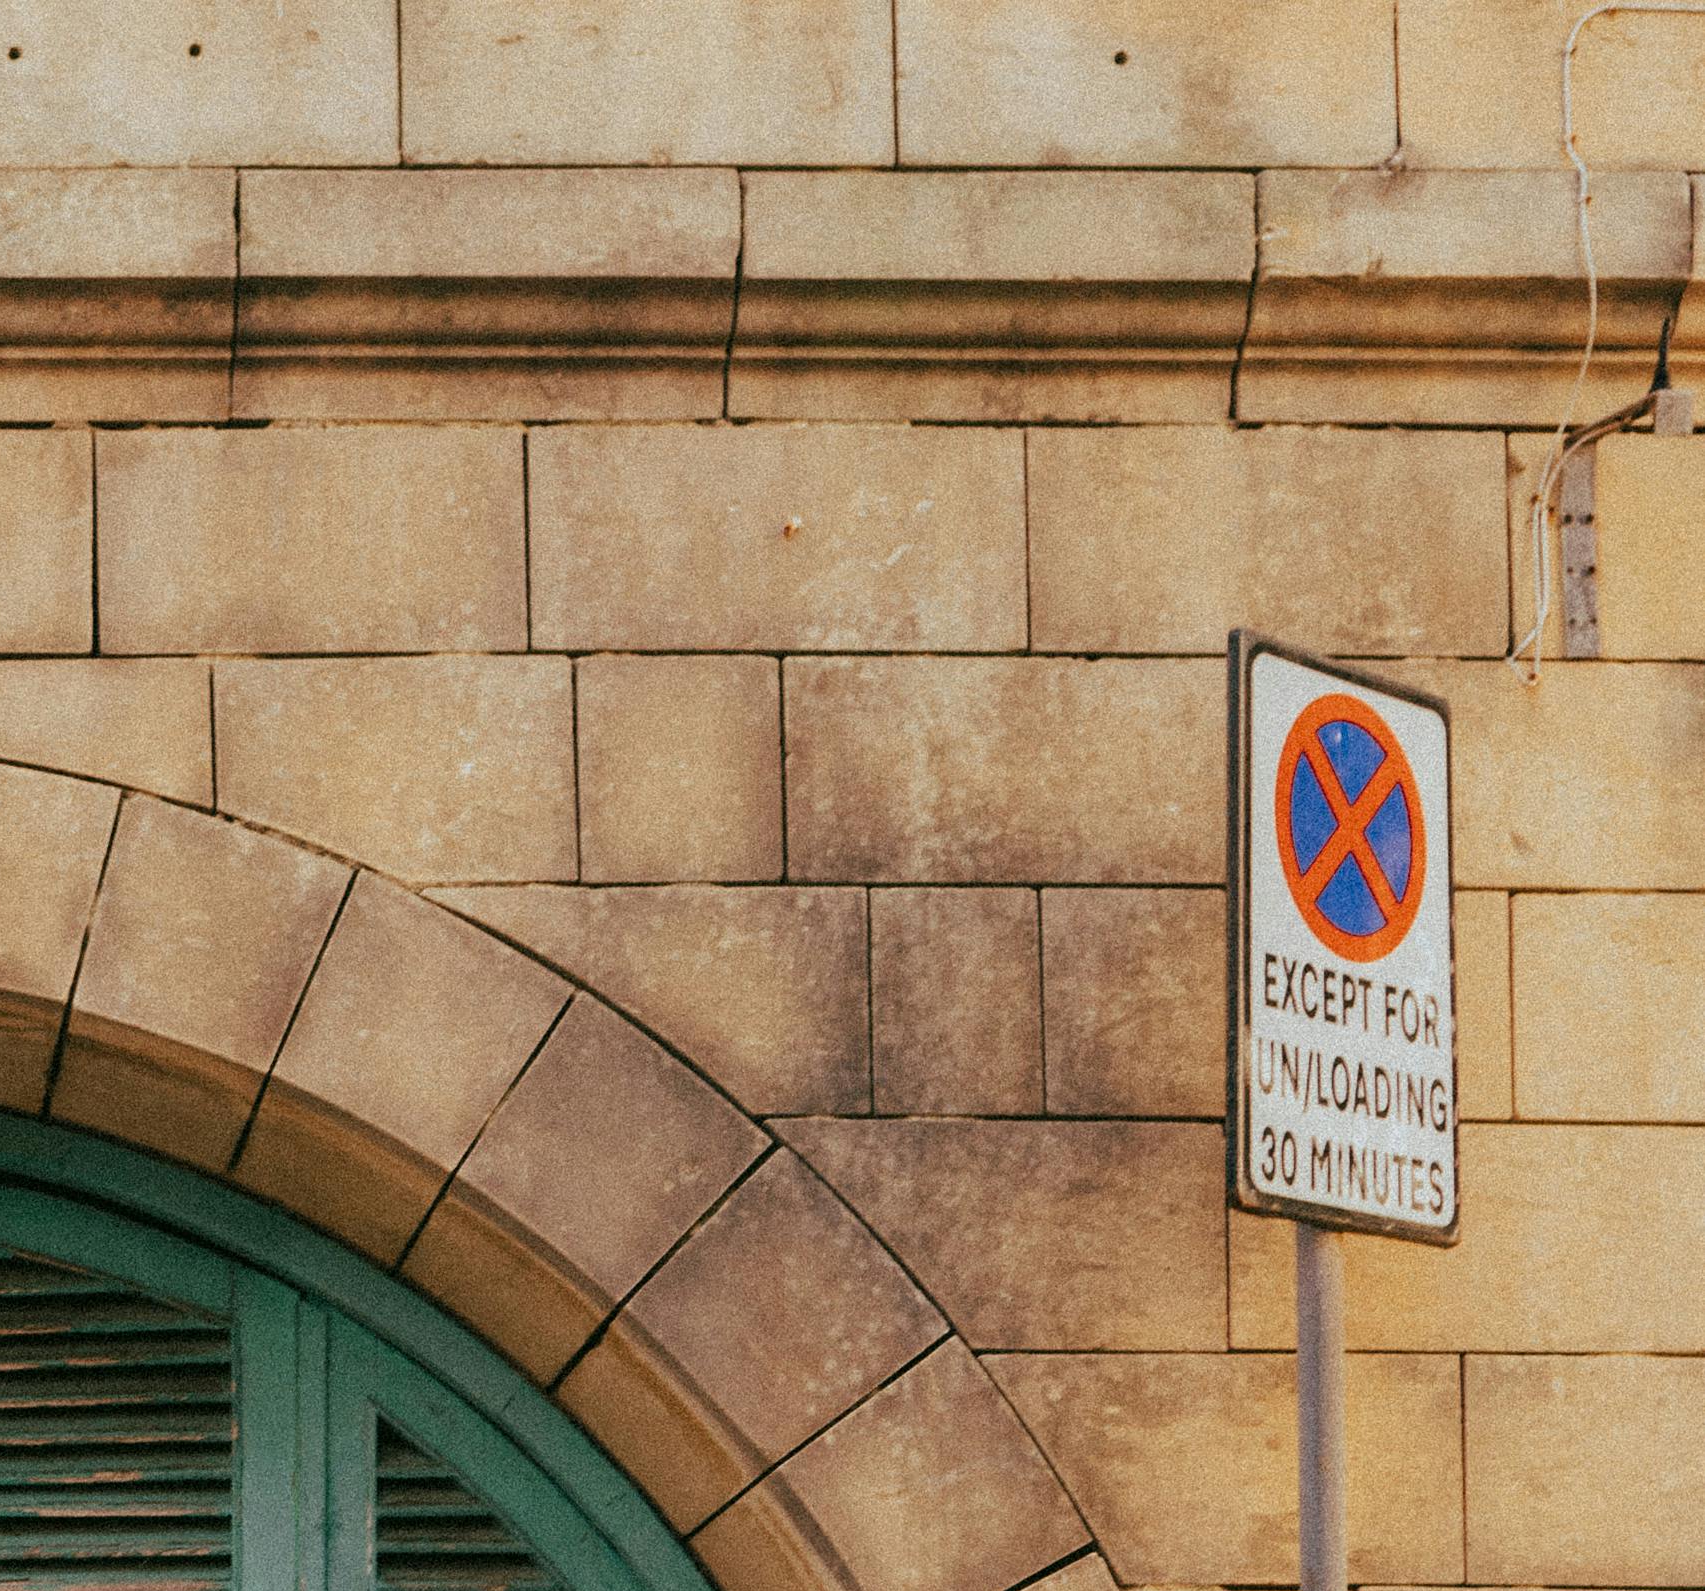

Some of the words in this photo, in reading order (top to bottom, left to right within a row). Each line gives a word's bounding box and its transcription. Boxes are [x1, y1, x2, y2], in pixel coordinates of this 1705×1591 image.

[1264, 952, 1372, 1032] EXCEPT
[1384, 984, 1440, 1048] FOR
[1258, 1037, 1446, 1132] UN/LOADING
[1261, 1126, 1296, 1186] 30
[1311, 1134, 1444, 1214] MINUTES
